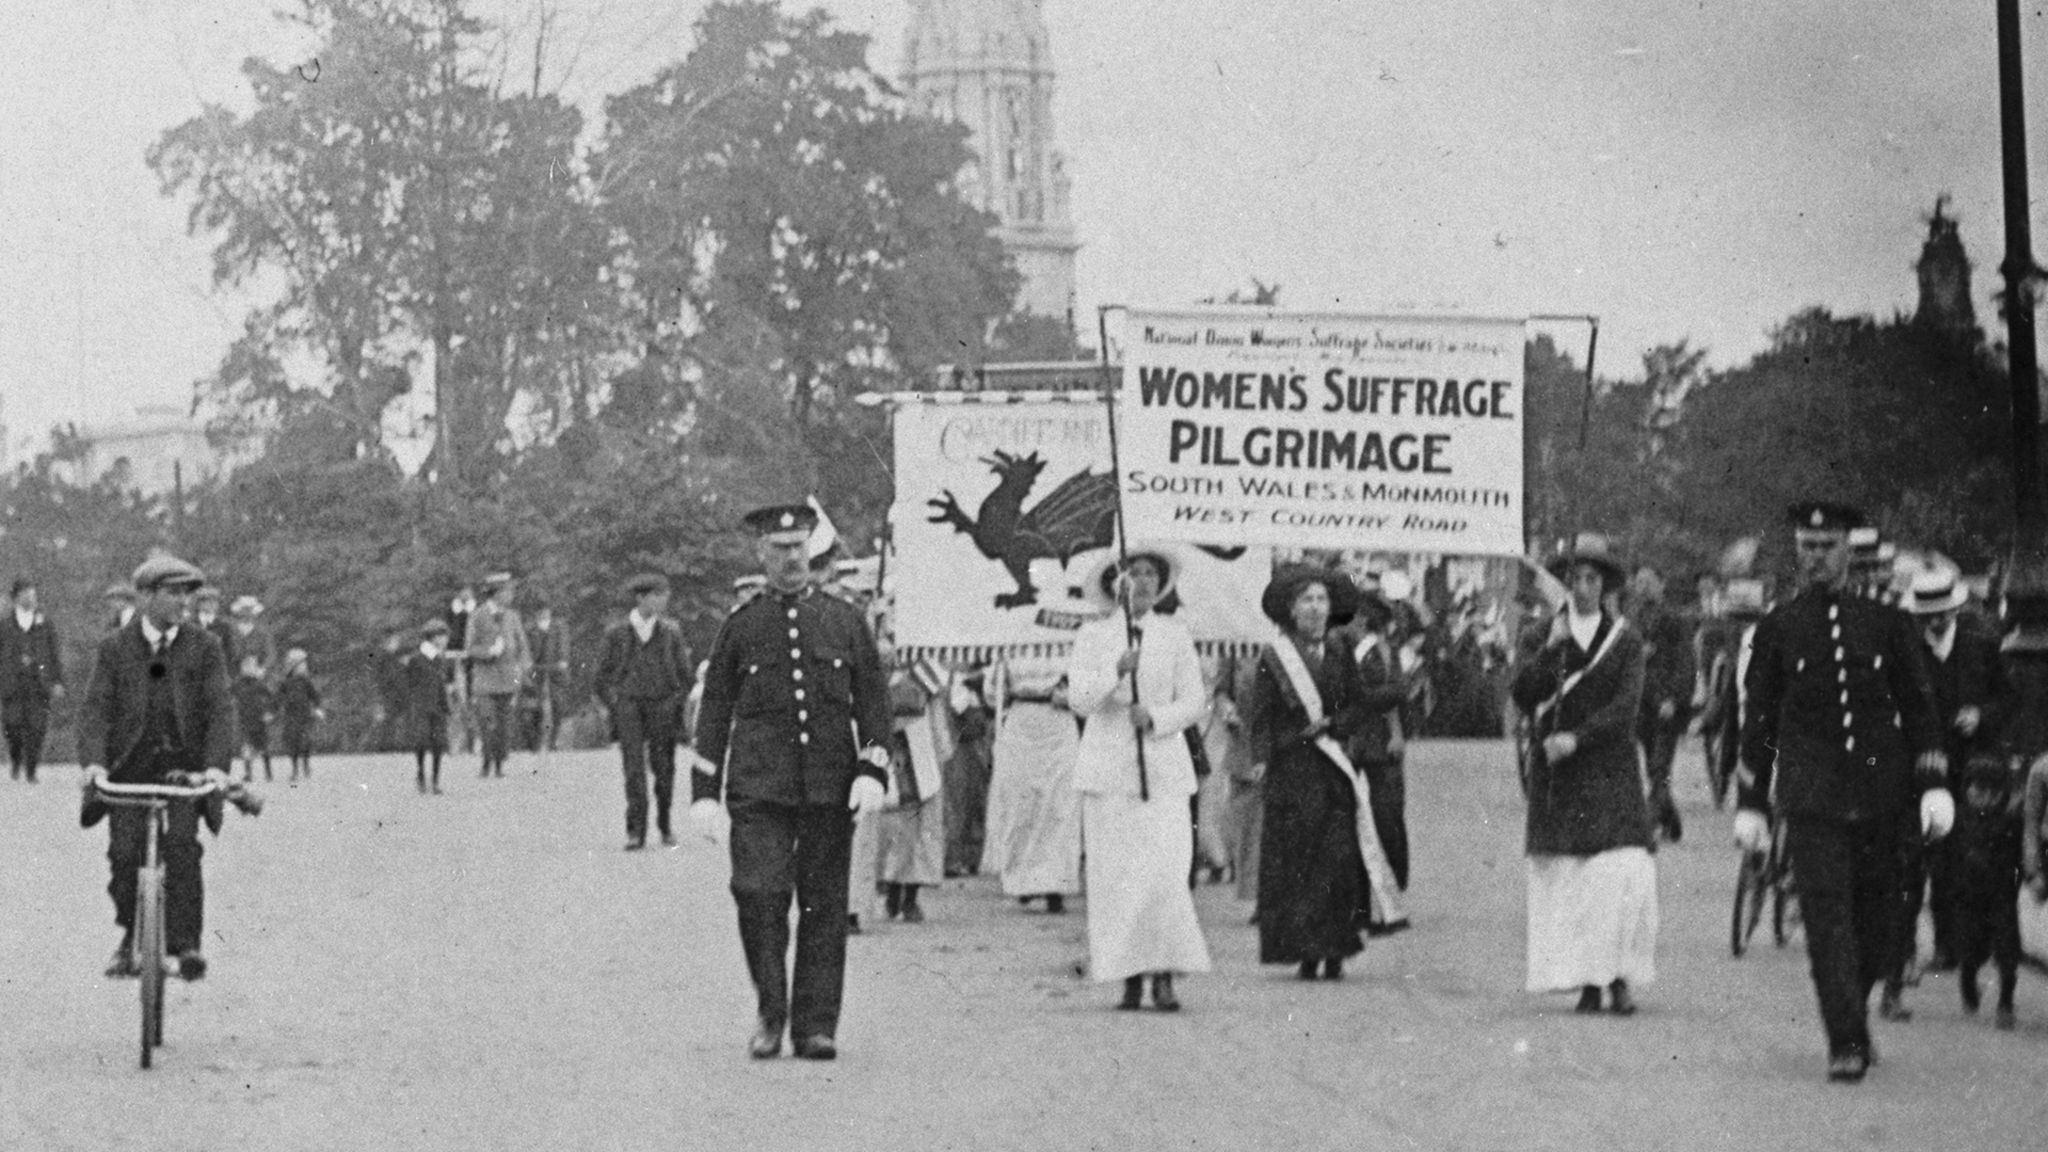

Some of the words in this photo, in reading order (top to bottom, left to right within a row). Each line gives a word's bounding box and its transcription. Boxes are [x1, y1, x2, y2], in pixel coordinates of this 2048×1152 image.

[1138, 366, 1309, 413] WOMEN'S
[1322, 367, 1515, 420] SUFFRAGE
[1169, 418, 1453, 474] PILGRIMAGE
[1127, 470, 1223, 495] SOUTH
[1239, 476, 1337, 501] WALES
[1362, 481, 1509, 509] MONMOUTH
[1174, 505, 1254, 525] WEST
[1270, 508, 1392, 530] COUNTRY
[1402, 513, 1468, 533] ROAD
